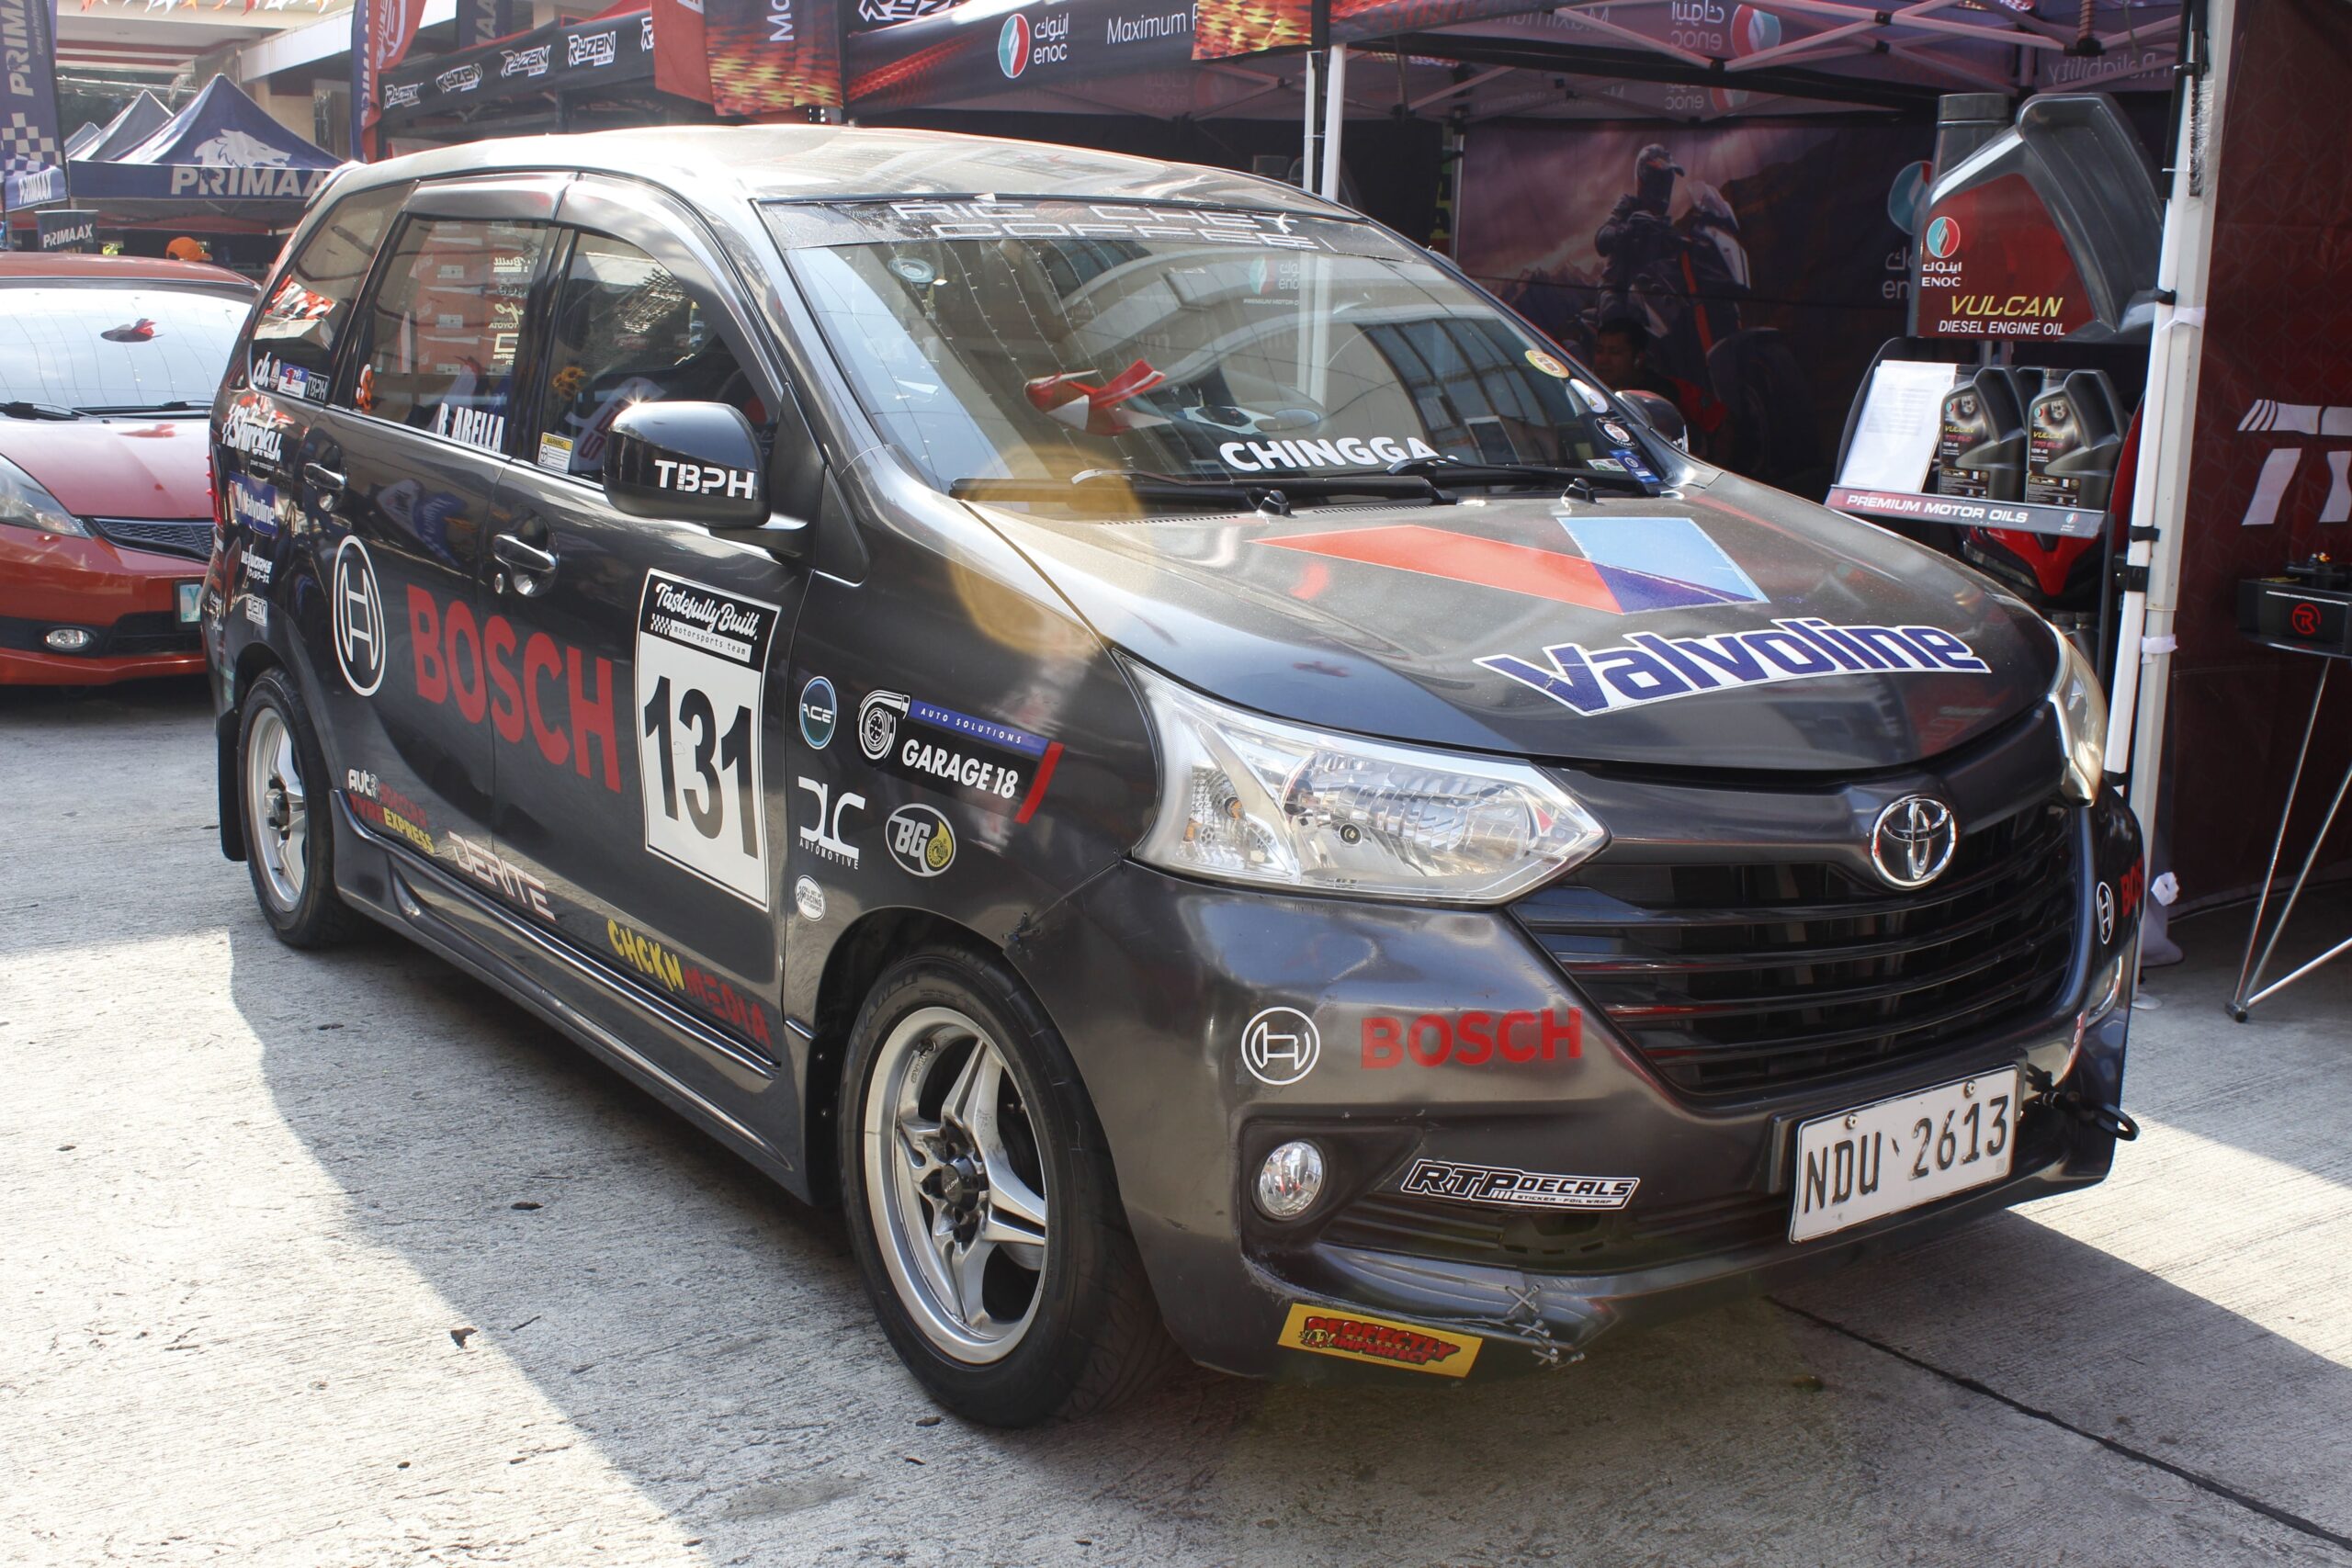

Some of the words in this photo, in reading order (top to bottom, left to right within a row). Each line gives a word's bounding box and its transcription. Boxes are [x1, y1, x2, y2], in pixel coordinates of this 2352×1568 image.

[1107, 13, 1186, 45] Maximum
[568, 31, 616, 67] RYZEN
[1034, 43, 1068, 65] enoc
[19, 172, 51, 205] PRIMAAX
[171, 167, 323, 197] PRIMAA
[43, 223, 93, 249] PRIMAAX
[1921, 277, 1962, 287] ENOC
[1951, 295, 2064, 317] VULCAN
[1939, 321, 1984, 333] DIESEL
[1987, 321, 2040, 335] ENGINE
[2043, 322, 2065, 336] OIL
[654, 459, 755, 500] TBPH
[242, 488, 276, 525] Valvoline
[1847, 495, 1921, 513] PREMIUM
[1923, 502, 1984, 519] MOTOR
[1988, 510, 2029, 524] OILS
[655, 582, 721, 634] Tastefully
[673, 626, 724, 648] motorsports
[727, 643, 746, 655] team
[1474, 617, 1992, 716] Valvoline
[406, 582, 622, 795] BOSCH
[921, 707, 949, 723] AUTO
[956, 718, 1023, 744] SOLUTIONS
[644, 675, 759, 860] 131
[901, 739, 994, 795] GARAGE
[992, 767, 1019, 799] 18
[383, 807, 435, 854] EXPRESS
[889, 815, 933, 858] BG
[799, 837, 859, 870] AUTOMOTIVE
[683, 965, 773, 1049] MEDIA
[1361, 1007, 1582, 1070] BOSCH
[1804, 1133, 1882, 1213] NDU
[1908, 1094, 2009, 1180] 2613
[1406, 1160, 1527, 1201] RTP
[1516, 1177, 1632, 1196] DECALS
